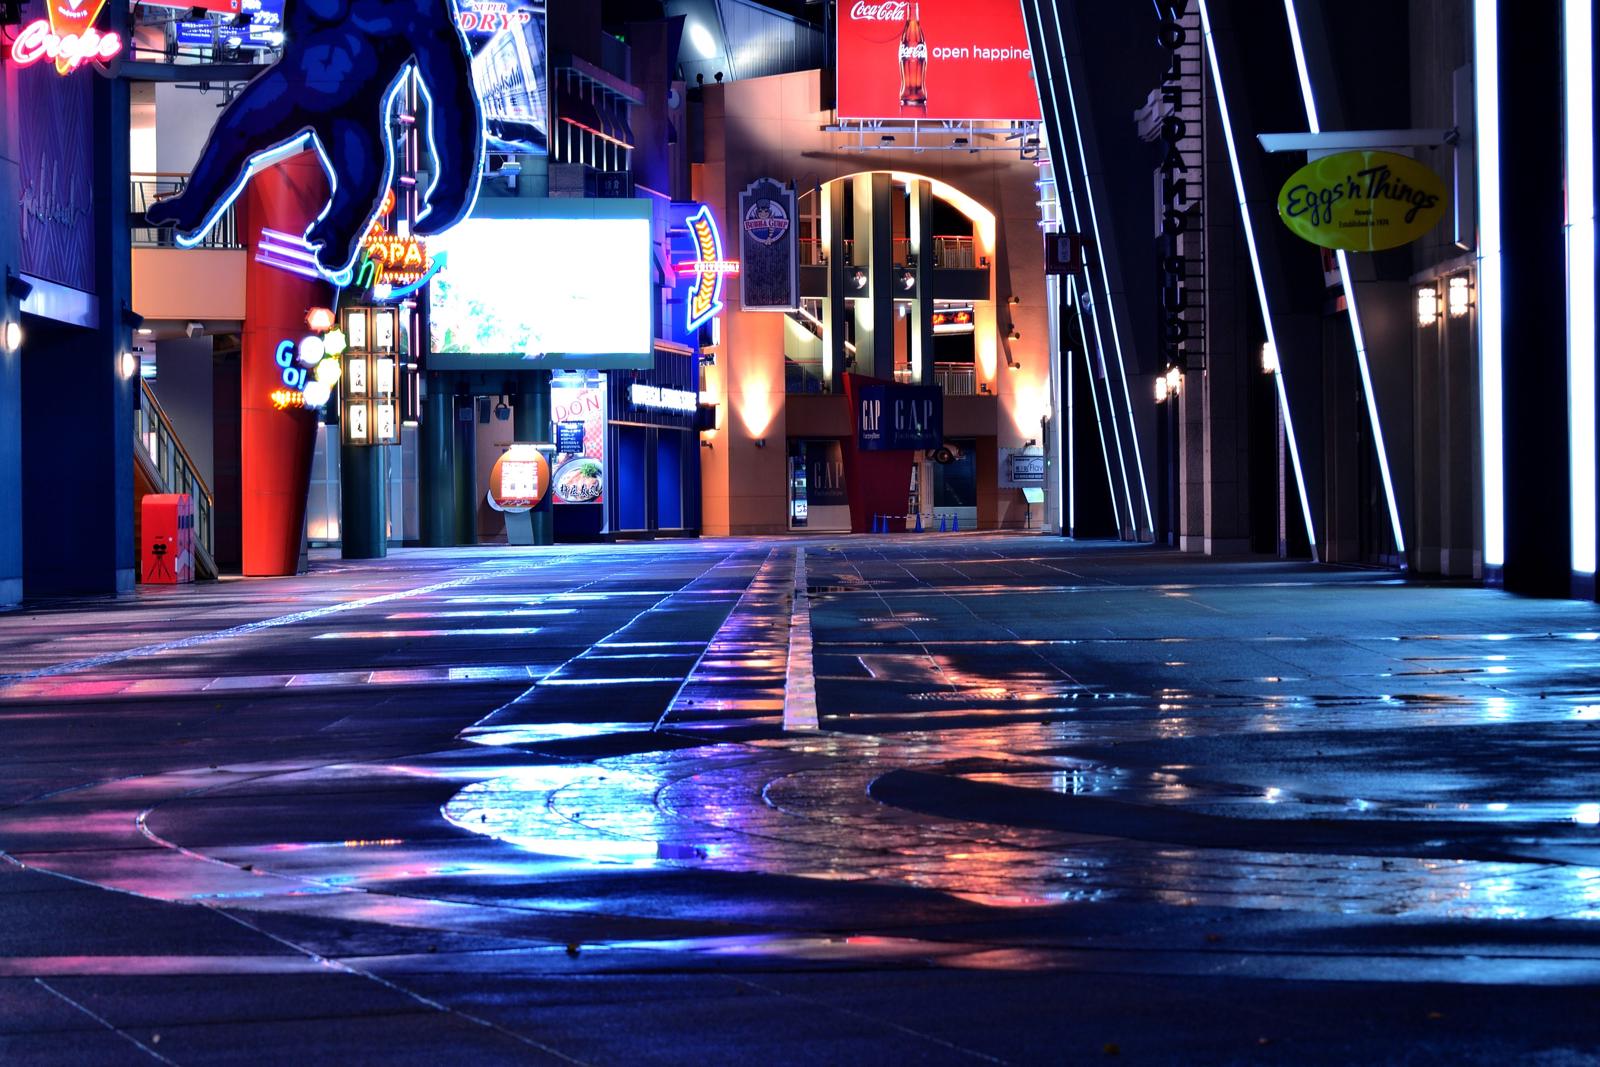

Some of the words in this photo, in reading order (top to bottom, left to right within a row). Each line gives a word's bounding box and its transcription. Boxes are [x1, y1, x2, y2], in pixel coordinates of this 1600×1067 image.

[932, 46, 969, 60] open
[1287, 181, 1344, 226] Eggs
[1357, 165, 1439, 224] Things
[744, 220, 767, 230] BUBBA
[768, 218, 789, 229] GUMP
[862, 399, 881, 431] GAP
[894, 399, 934, 431] GAP
[814, 462, 843, 489] GAP
